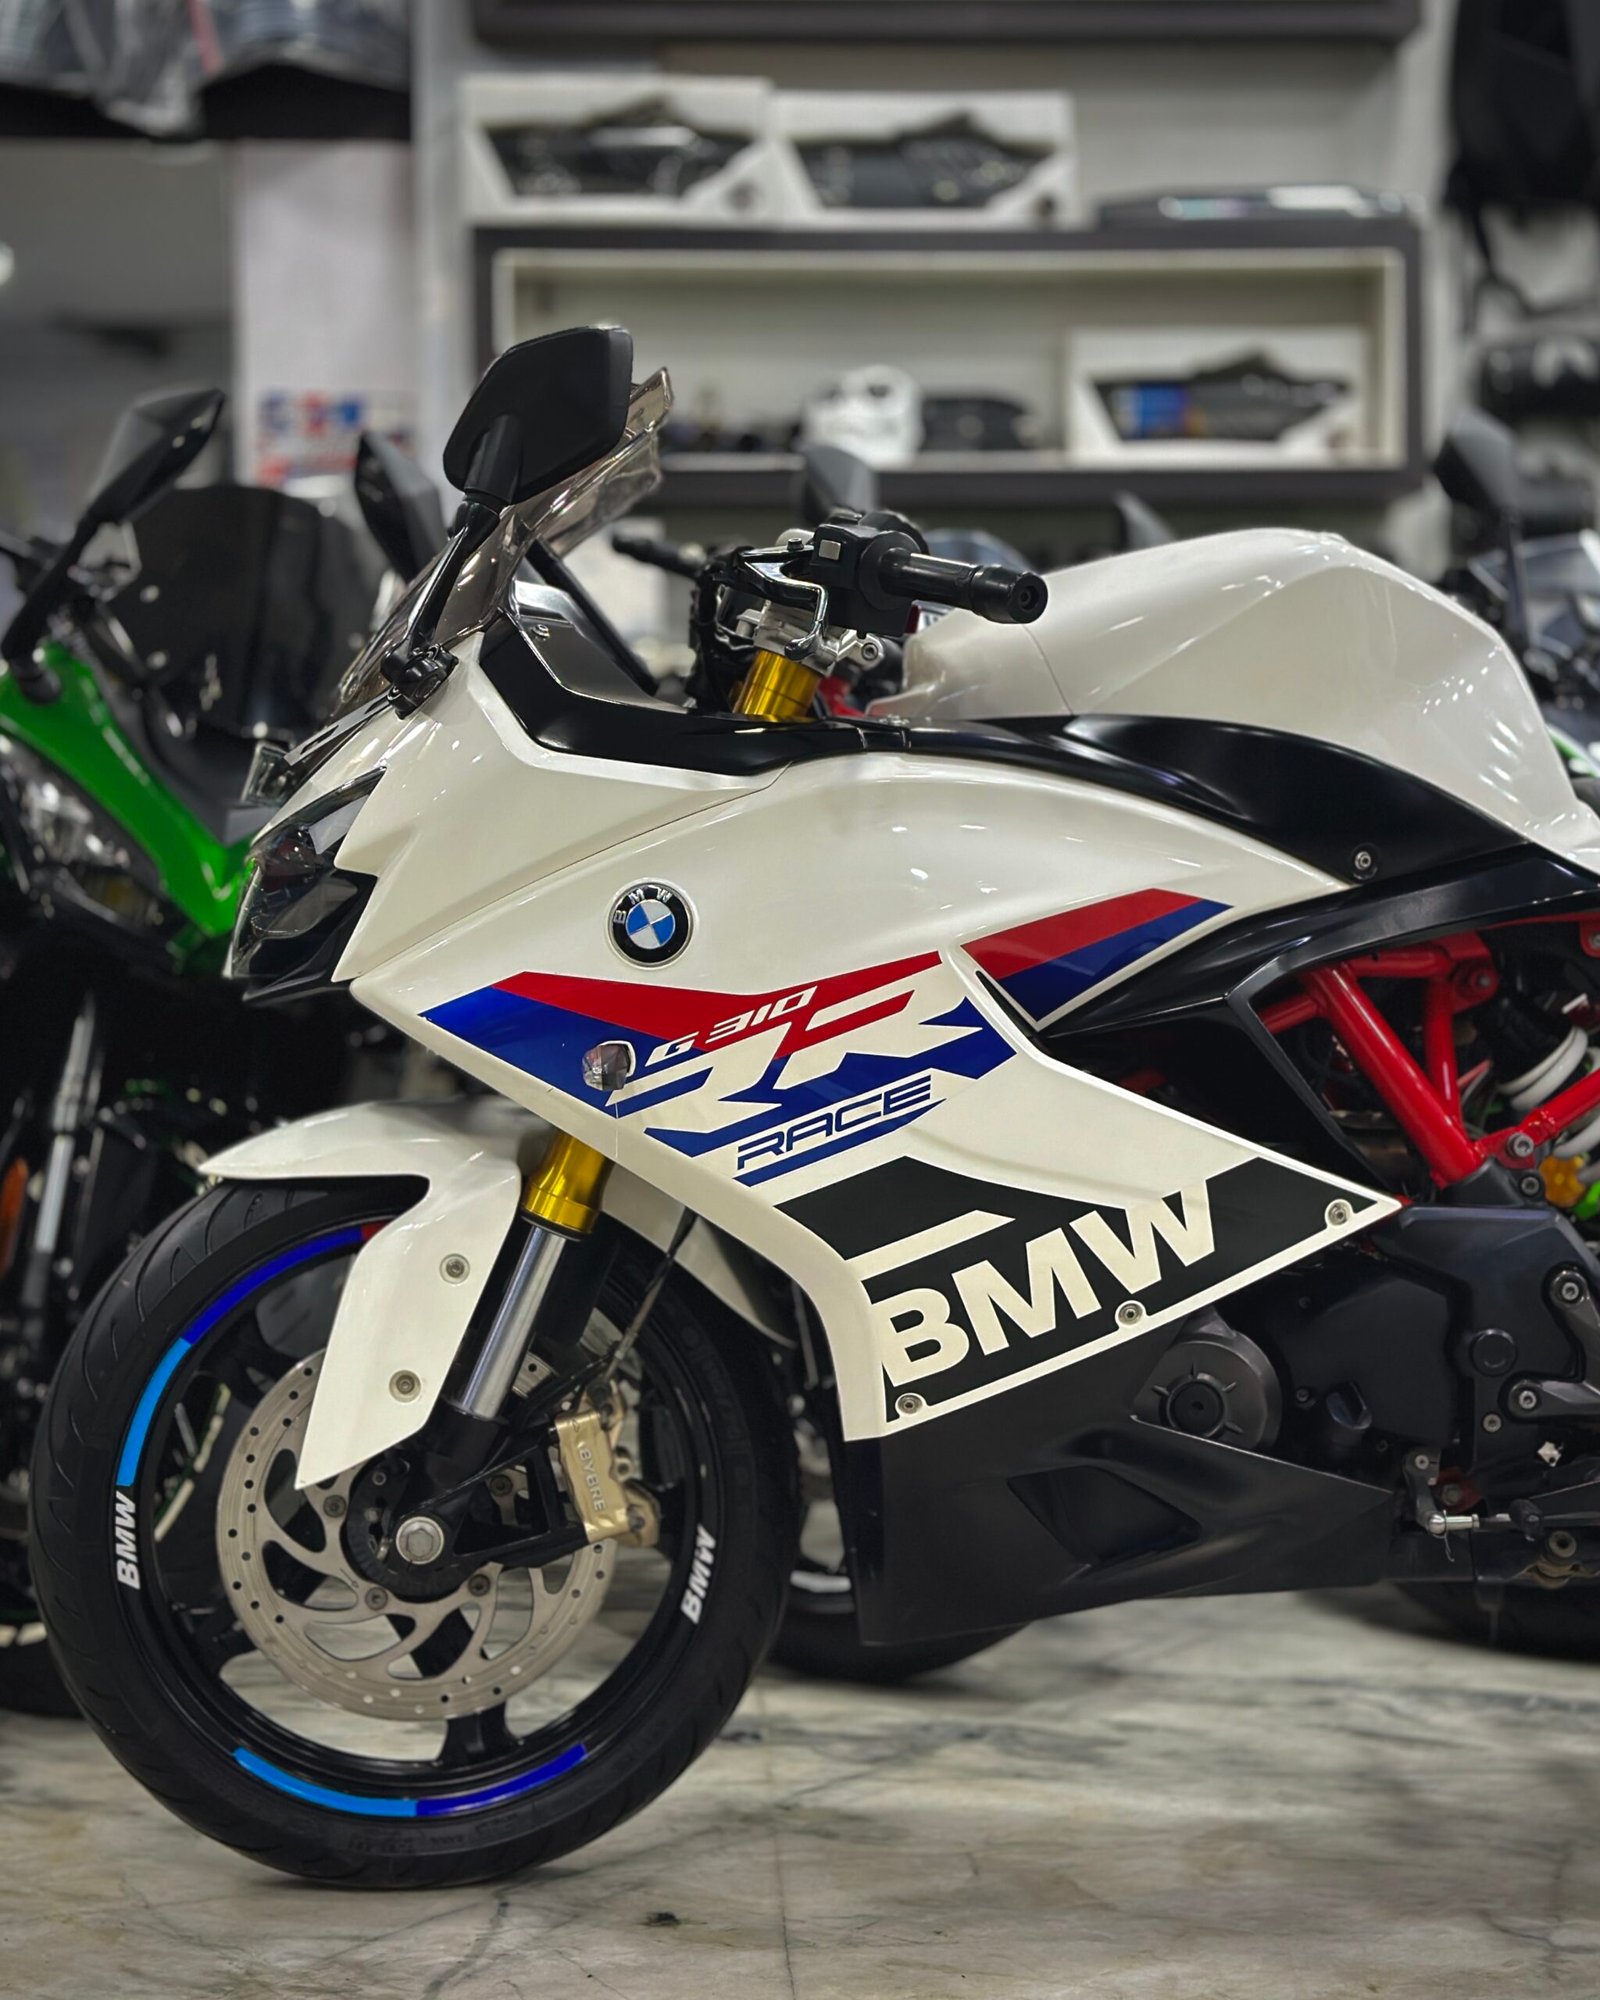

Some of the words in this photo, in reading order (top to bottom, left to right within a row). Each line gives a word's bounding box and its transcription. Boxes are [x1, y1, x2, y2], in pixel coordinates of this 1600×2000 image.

[612, 888, 673, 925] BMW
[645, 1032, 699, 1067] G
[708, 985, 818, 1043] 310
[737, 1074, 932, 1171] RACE
[870, 1178, 1216, 1388] BMW
[579, 1447, 607, 1512] BYBRE
[114, 1489, 142, 1591] BMW
[680, 1522, 717, 1625] BMW
